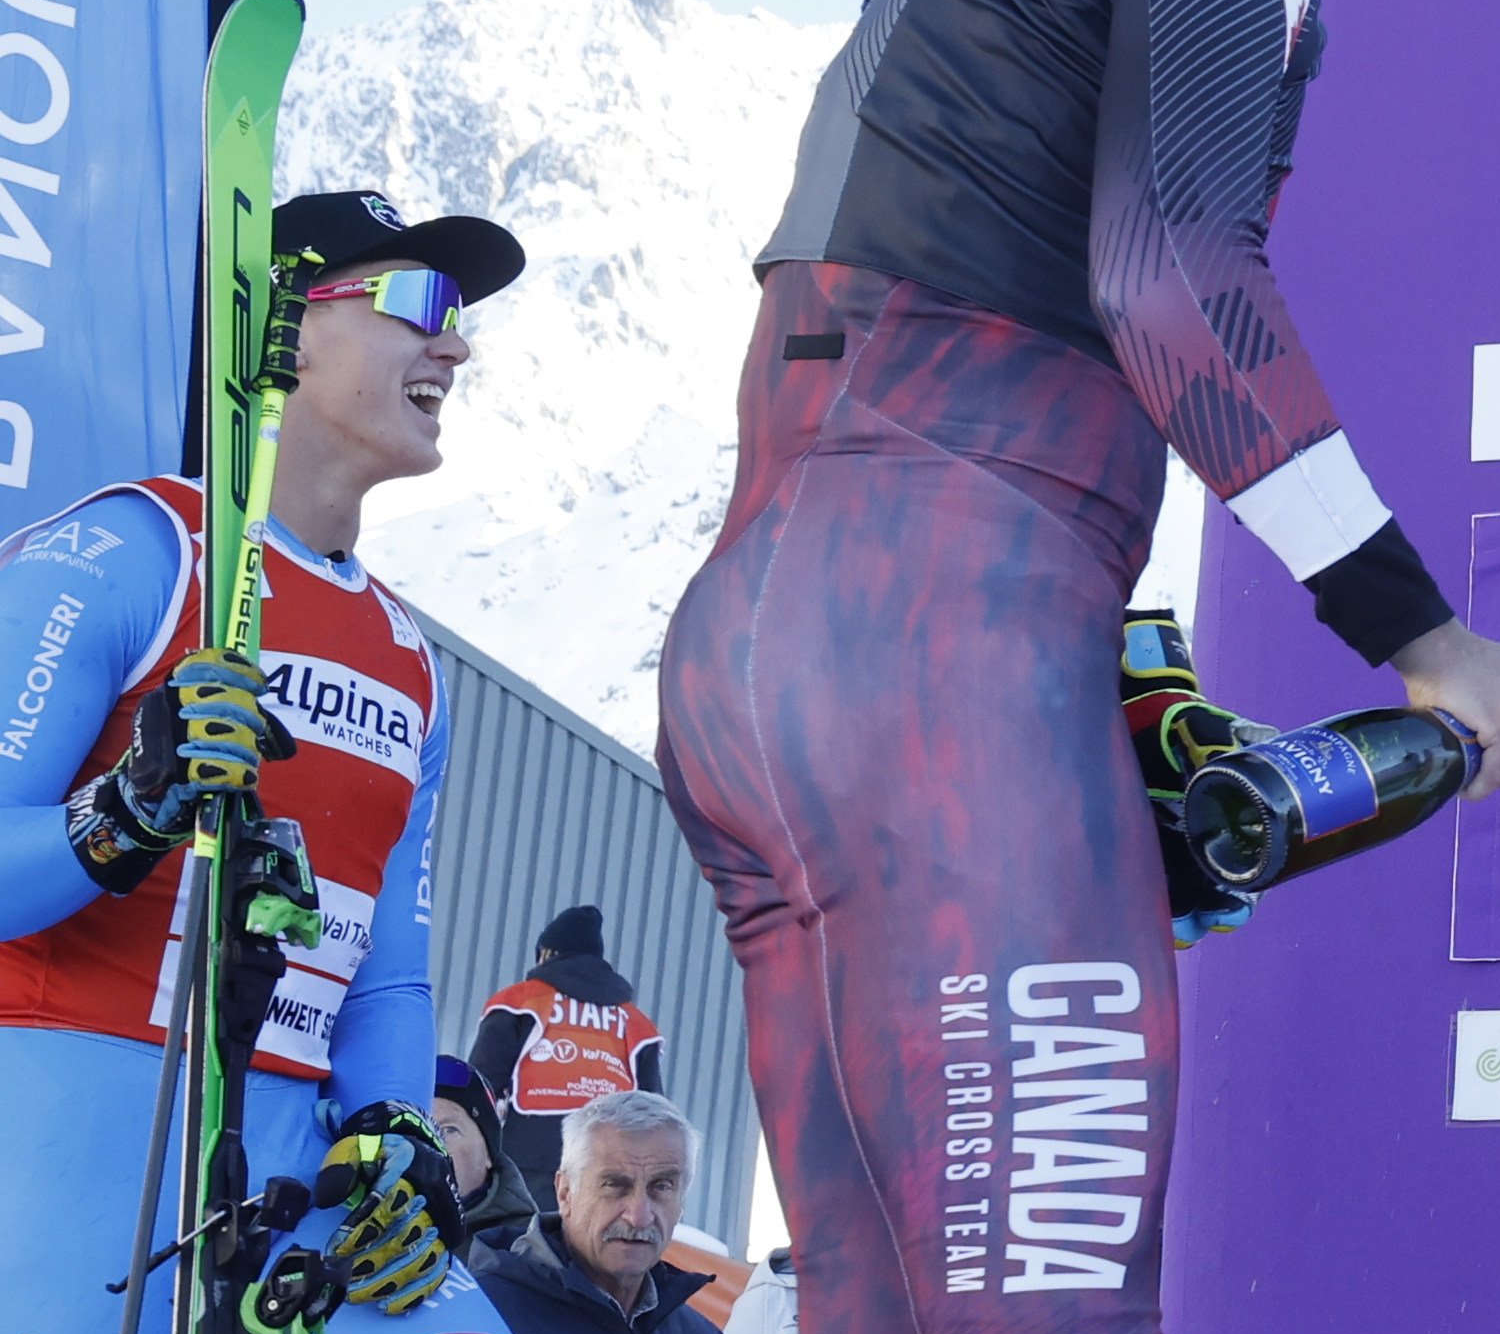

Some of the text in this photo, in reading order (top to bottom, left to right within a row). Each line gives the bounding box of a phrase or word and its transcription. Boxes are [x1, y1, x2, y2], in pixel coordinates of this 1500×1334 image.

[0, 593, 85, 761] FALCONERI
[263, 663, 413, 751] Alpina
[322, 721, 393, 759] WATCHES
[1270, 739, 1334, 796] AVIGNY
[321, 911, 351, 941] Val
[939, 972, 994, 1294] SKI CROSS TEAM
[1002, 961, 1148, 1294] CANADA
